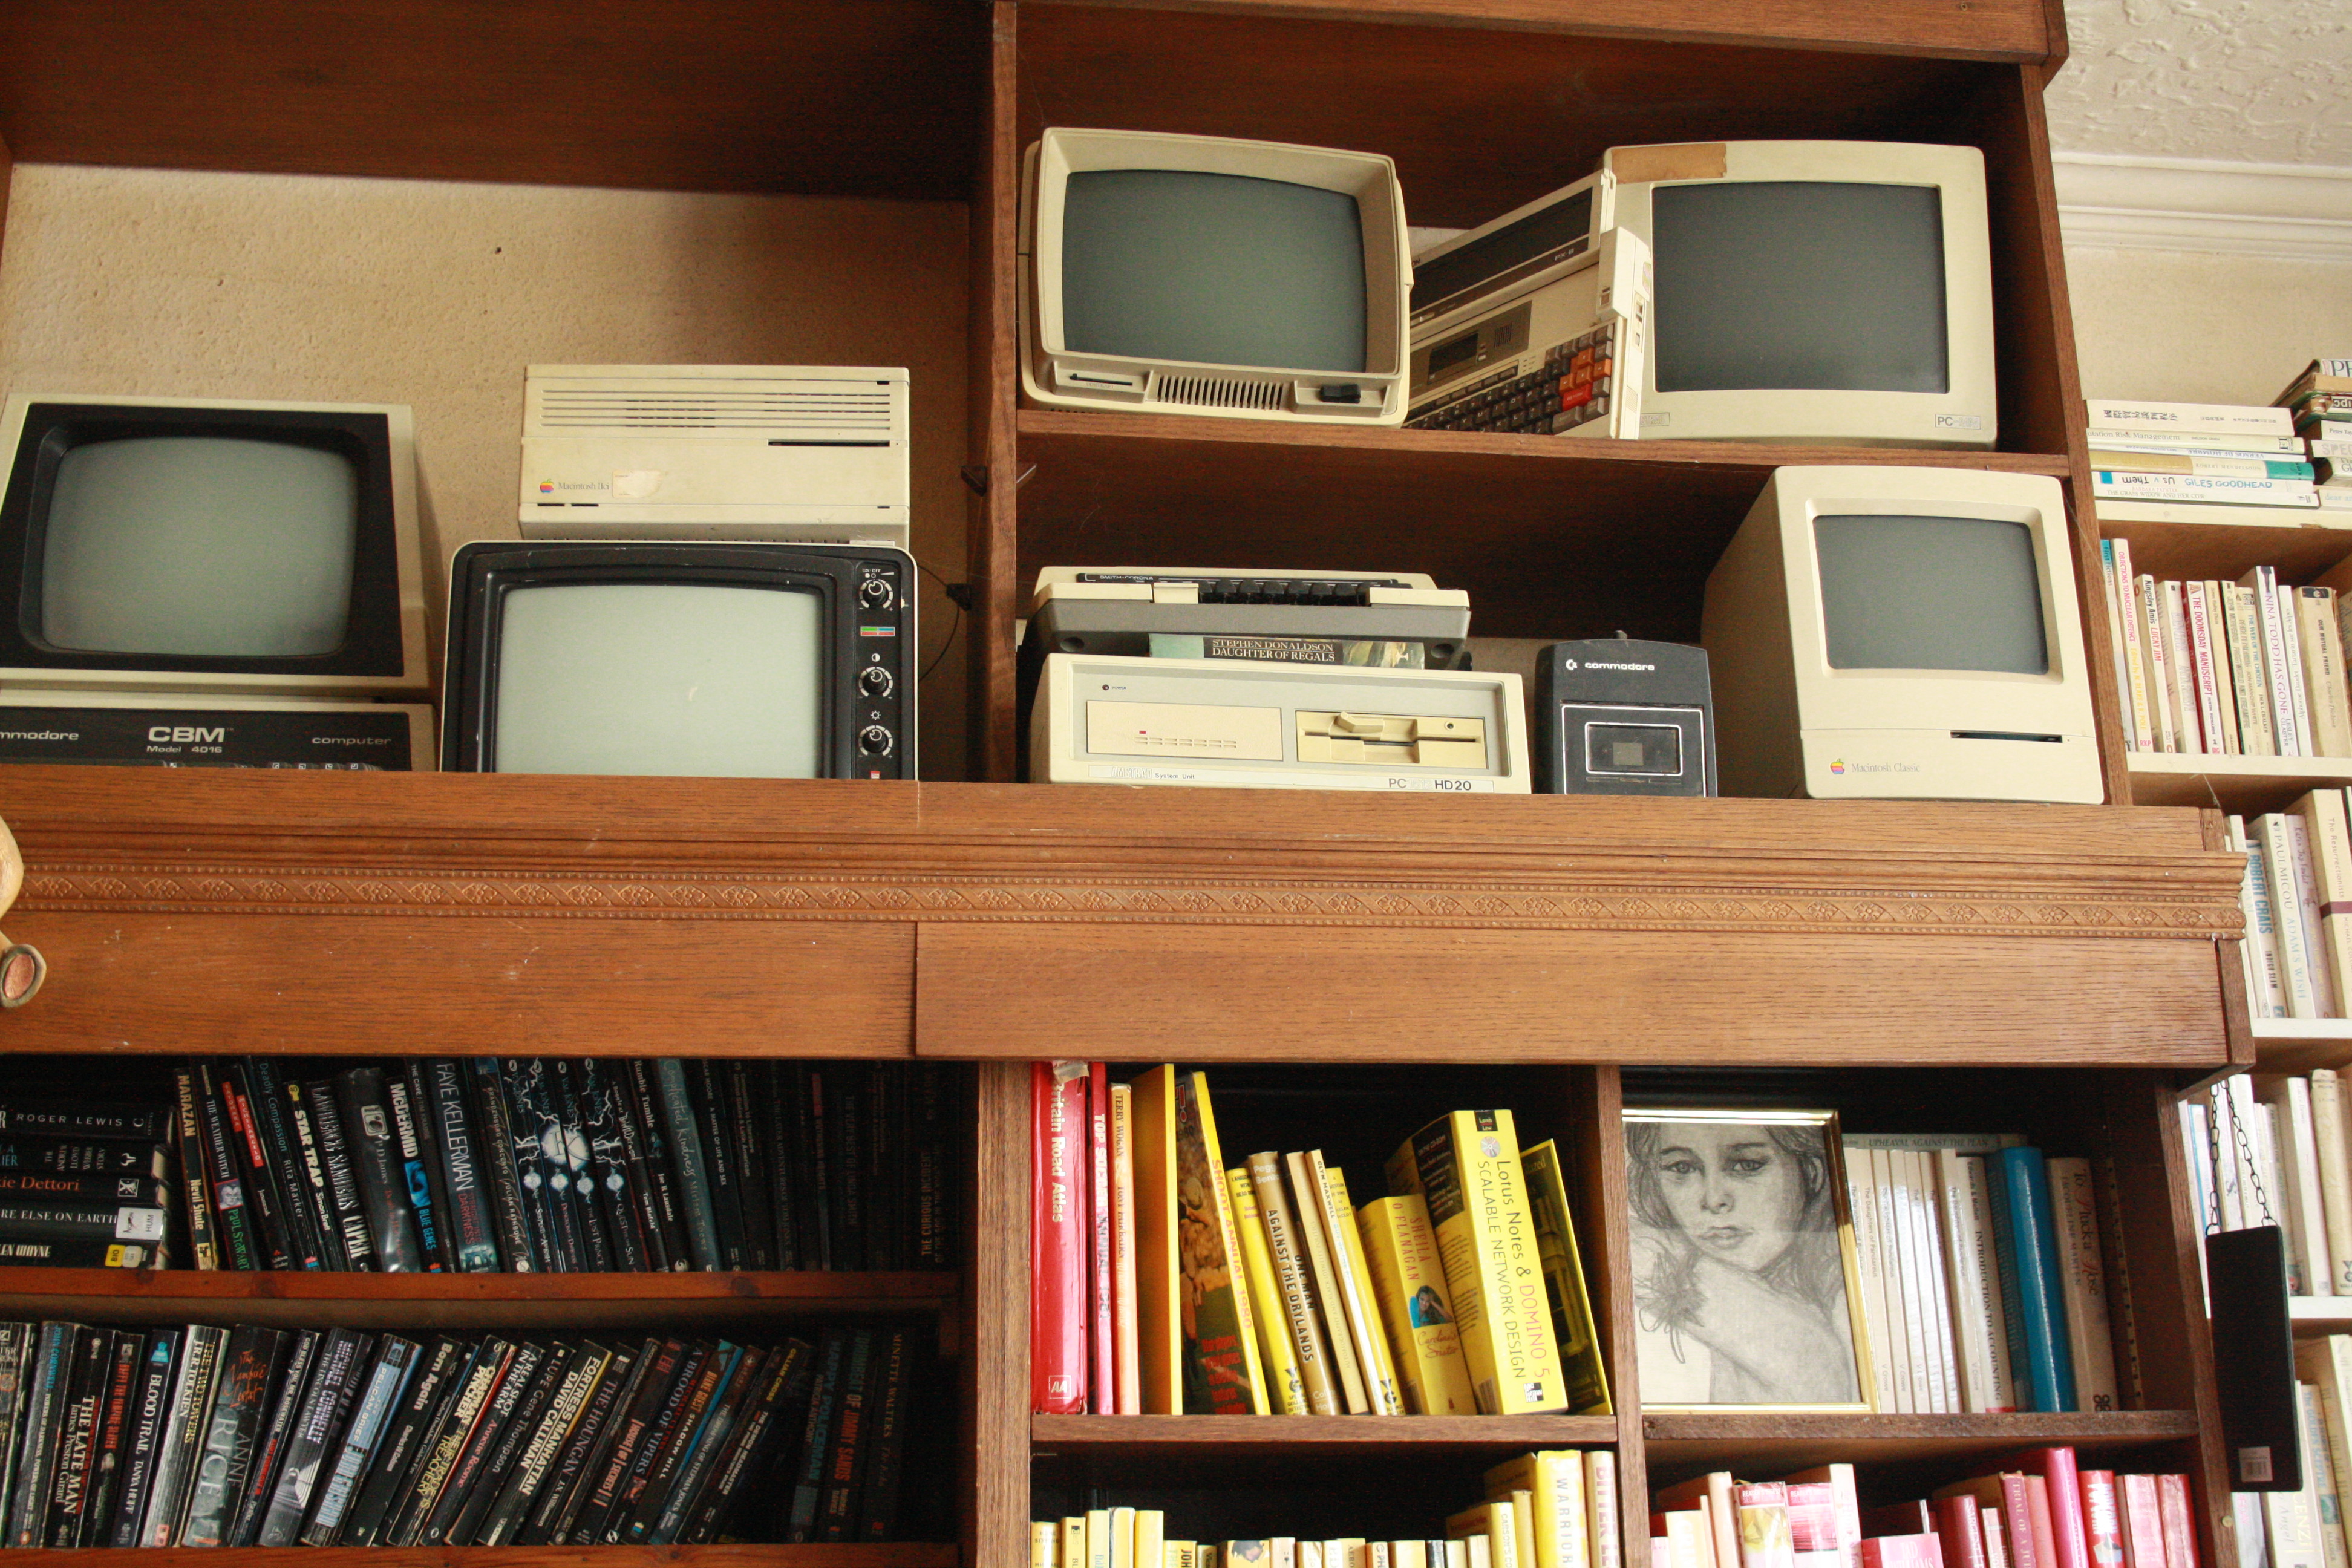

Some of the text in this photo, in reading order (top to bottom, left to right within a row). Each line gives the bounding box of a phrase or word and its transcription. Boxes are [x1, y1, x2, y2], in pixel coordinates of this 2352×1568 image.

[2133, 433, 2180, 441] Management
[2184, 479, 2272, 489] GILES GOODHEAD
[2118, 551, 2129, 583] OBJECTIONS
[2123, 593, 2133, 619] NUCLEAR
[2126, 619, 2135, 642] DEFENCE
[2143, 580, 2161, 661] Kingsley Amis LUCKY JIM
[2247, 615, 2255, 625] THE
[2249, 627, 2257, 639] WEB
[1212, 639, 1333, 651] STEPHEN DONALDSON
[1212, 647, 1335, 662] DAUGHTER OF REGALS
[1585, 662, 1655, 671] commodore
[2192, 596, 2212, 696] THE DOOMSDAY MANUSCRIPT
[2265, 595, 2288, 715] NINA TODD HAS GONE
[0, 731, 79, 740] mmodore
[148, 727, 225, 742] CBM
[312, 737, 392, 745] computer
[1111, 766, 1152, 779] AMSTRAD
[1434, 780, 1471, 791] HD20
[1852, 763, 1920, 772] Macintosh Classic
[2328, 818, 2345, 898] The Resurrectionists
[2247, 854, 2273, 935] ROBERT CRAIS
[2273, 835, 2306, 999] PAUL MICOU ADAM'S WISH
[2264, 950, 2278, 989] INDIGO SLAM
[16, 1113, 123, 1126] ROGER LEWIS
[177, 1074, 197, 1137] MARAZAN
[634, 1060, 655, 1128] Rumble Tumble
[663, 1059, 698, 1177] Complicated Kindness
[206, 1100, 229, 1178] THE WEATHER WITCH
[258, 1062, 304, 1218] Deadly Compassion Rita Marker
[293, 1108, 325, 1189] STAR TRAP
[436, 1062, 474, 1191] FAYE KELLERMAN
[21, 1176, 80, 1191] Dettori
[1051, 1137, 1066, 1177] Road
[21, 1210, 51, 1221] ELSE
[56, 1212, 73, 1221] ON
[77, 1212, 117, 1224] EARTH
[190, 1178, 207, 1230] Nevil Shute
[921, 1195, 932, 1235] CURIOUS
[1051, 1181, 1066, 1223] Atlas
[1317, 1160, 1336, 1219] GLYN MAXWELL
[1864, 1201, 1873, 1233] Daughters
[111, 1249, 119, 1263] BIO
[342, 1214, 372, 1259] CAPER
[418, 1208, 438, 1250] BLUE GENES
[921, 1238, 932, 1255] THE
[1210, 1157, 1252, 1329] SHOOT ANNUAL 1980
[1391, 1202, 1420, 1281] O'FLANAGAN
[1409, 1216, 1432, 1263] SHEILA
[1267, 1209, 1314, 1362] AGAINST THE DRYLANDS
[1293, 1254, 1314, 1311] ONE MAN
[1478, 1161, 1526, 1379] SCALABLE NETWORK DESIGN
[1497, 1160, 1550, 1378] Lotus Notes & DOMINO 5
[1975, 1230, 2002, 1400] INTRODUCTION TO ACCOUNTING
[351, 1366, 387, 1443] PELICAN BRIEF
[411, 1341, 454, 1413] Born Again
[452, 1364, 486, 1419] PINCHER
[461, 1364, 497, 1426] CHAPMAN
[493, 1349, 530, 1409] IN THE ARM
[491, 1358, 561, 1475] LUPE Gene Thompson
[519, 1370, 578, 1471] DAVID CALLINAN
[521, 1356, 601, 1497] FORTRESS MANHATTAN
[561, 1377, 618, 1477] THE HOUNGAN
[635, 1347, 703, 1475] A BROOD OF VIPERS
[54, 1403, 80, 1504] James Preston Girard
[63, 1393, 95, 1514] THE LATE MAN
[198, 1416, 238, 1498] RICE
[226, 1432, 251, 1489] ANNE
[416, 1433, 451, 1495] TREACHERY
[658, 1413, 696, 1481] SHADOW HILL
[1900, 1543, 1918, 1558] TAD
